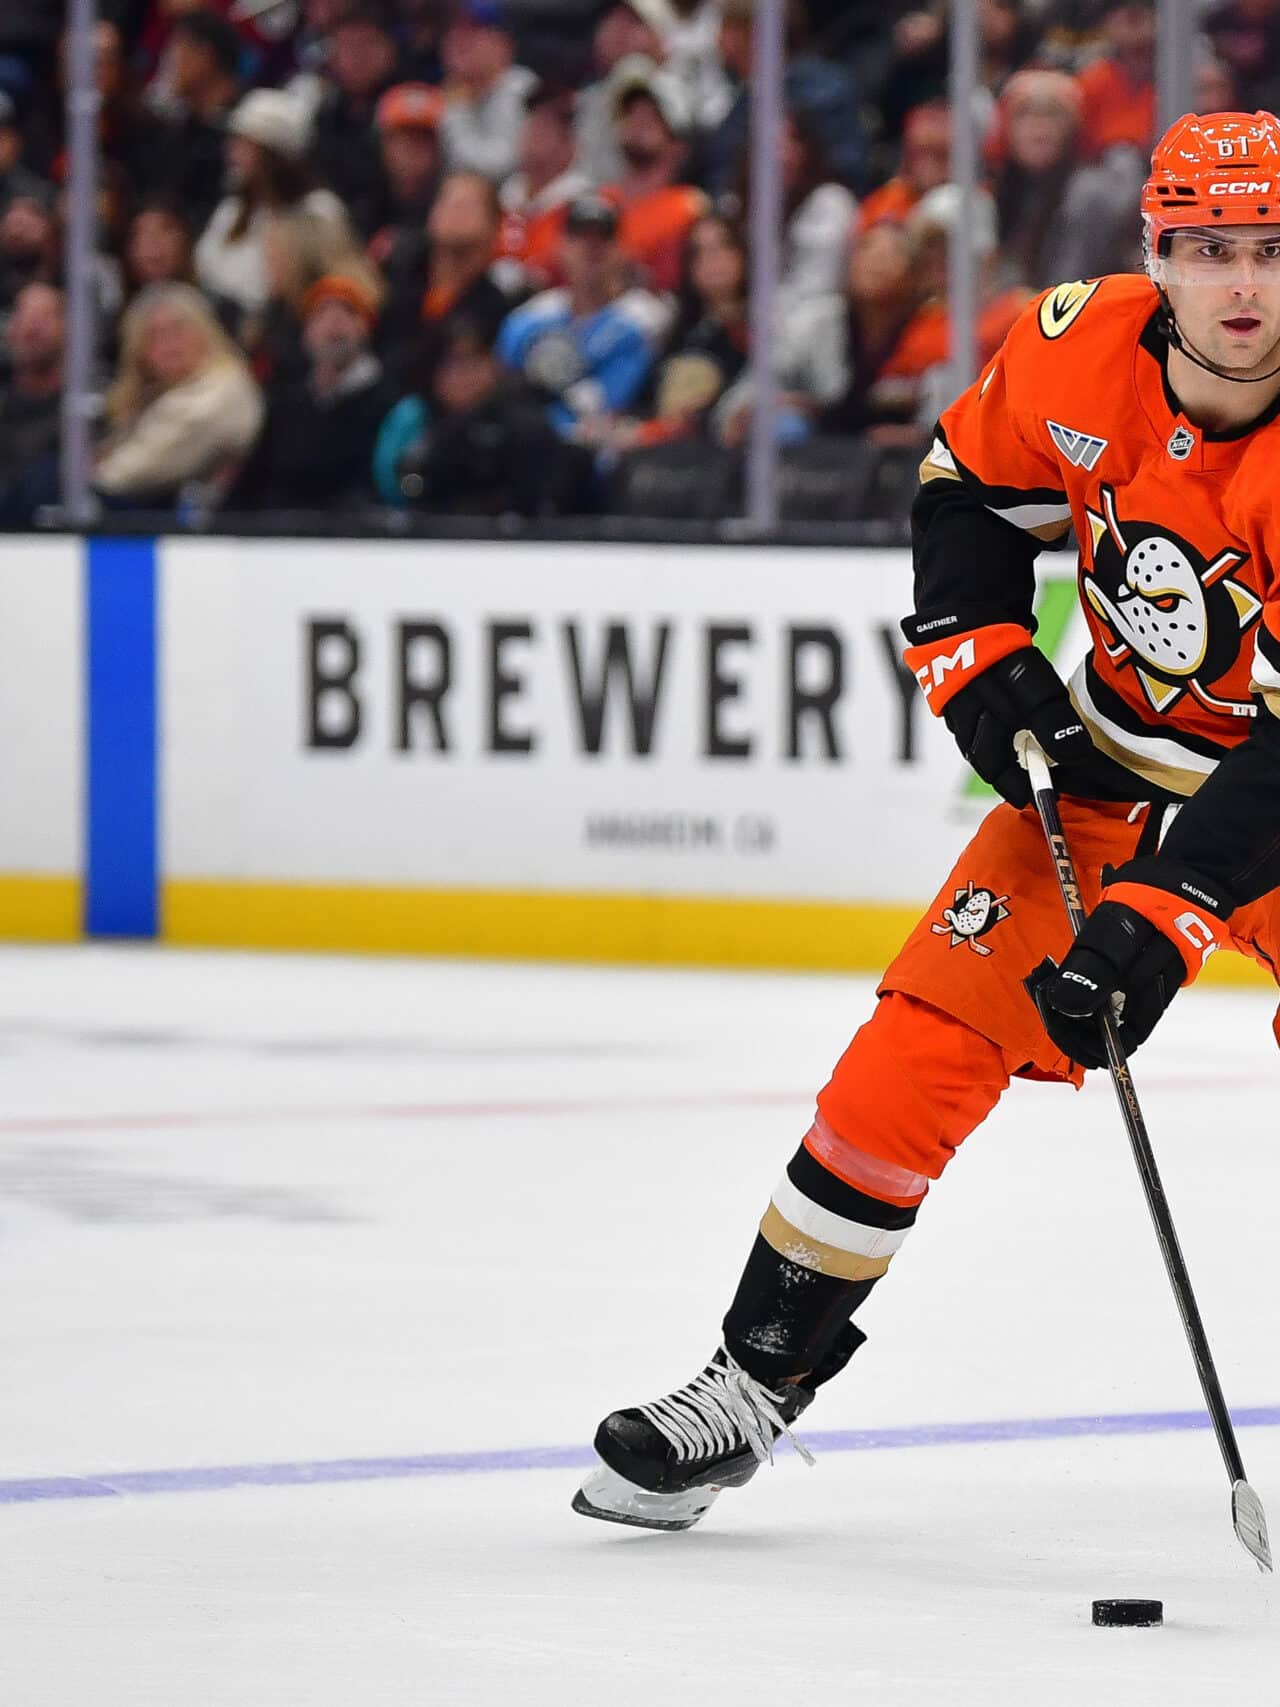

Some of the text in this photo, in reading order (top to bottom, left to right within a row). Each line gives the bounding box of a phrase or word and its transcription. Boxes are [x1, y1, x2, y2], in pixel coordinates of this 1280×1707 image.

[1217, 136, 1250, 158] 61
[1208, 182, 1271, 195] CCM
[916, 615, 958, 633] GAUTHIER
[305, 617, 922, 764] BREWERY
[1050, 834, 1082, 910] CCM
[1181, 882, 1219, 908] GAUTHIER
[1062, 971, 1098, 991] CCM
